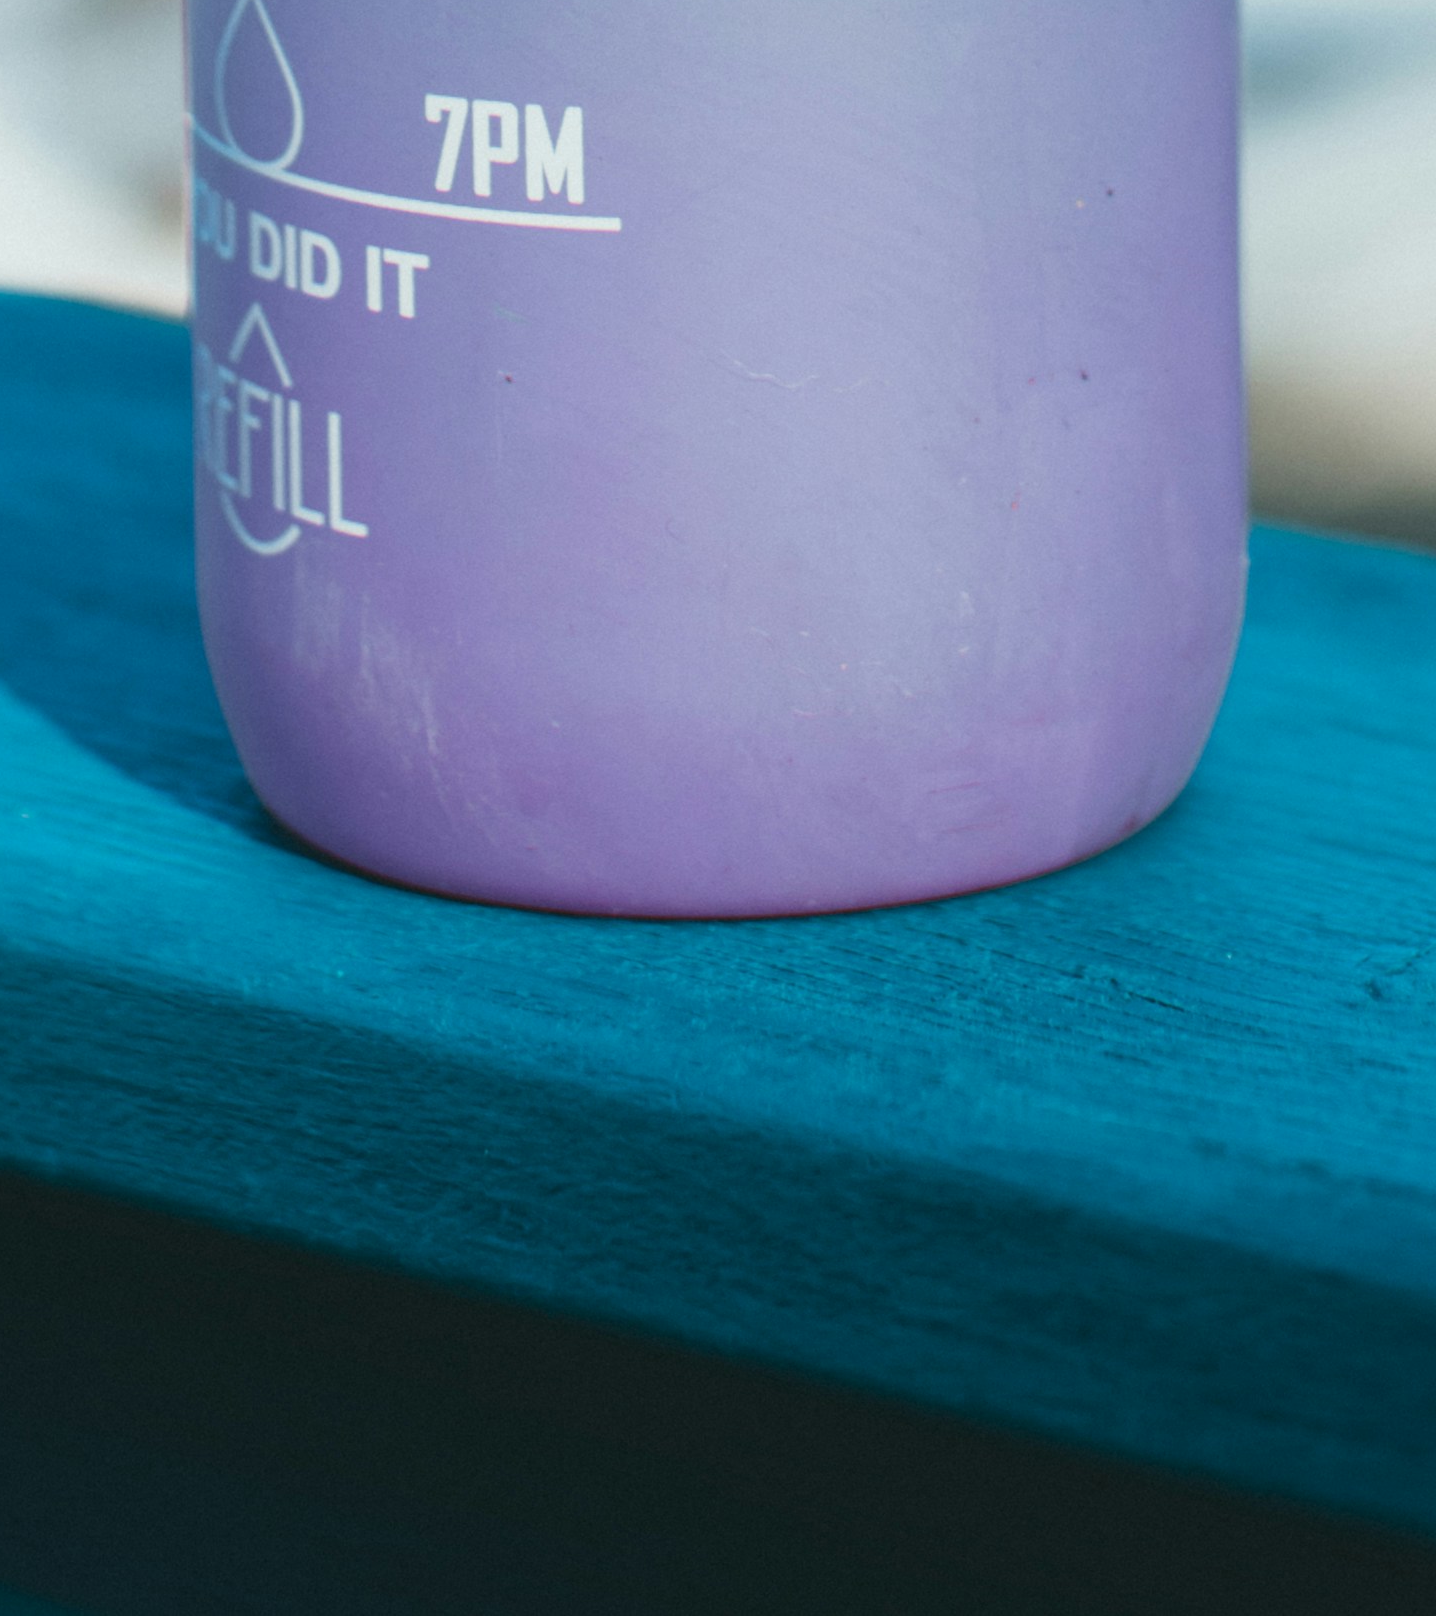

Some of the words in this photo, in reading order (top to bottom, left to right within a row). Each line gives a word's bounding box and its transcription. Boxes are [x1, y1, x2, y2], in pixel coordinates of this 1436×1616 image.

[425, 93, 584, 205] 7PM
[249, 210, 341, 299] DID
[367, 245, 430, 318] IT
